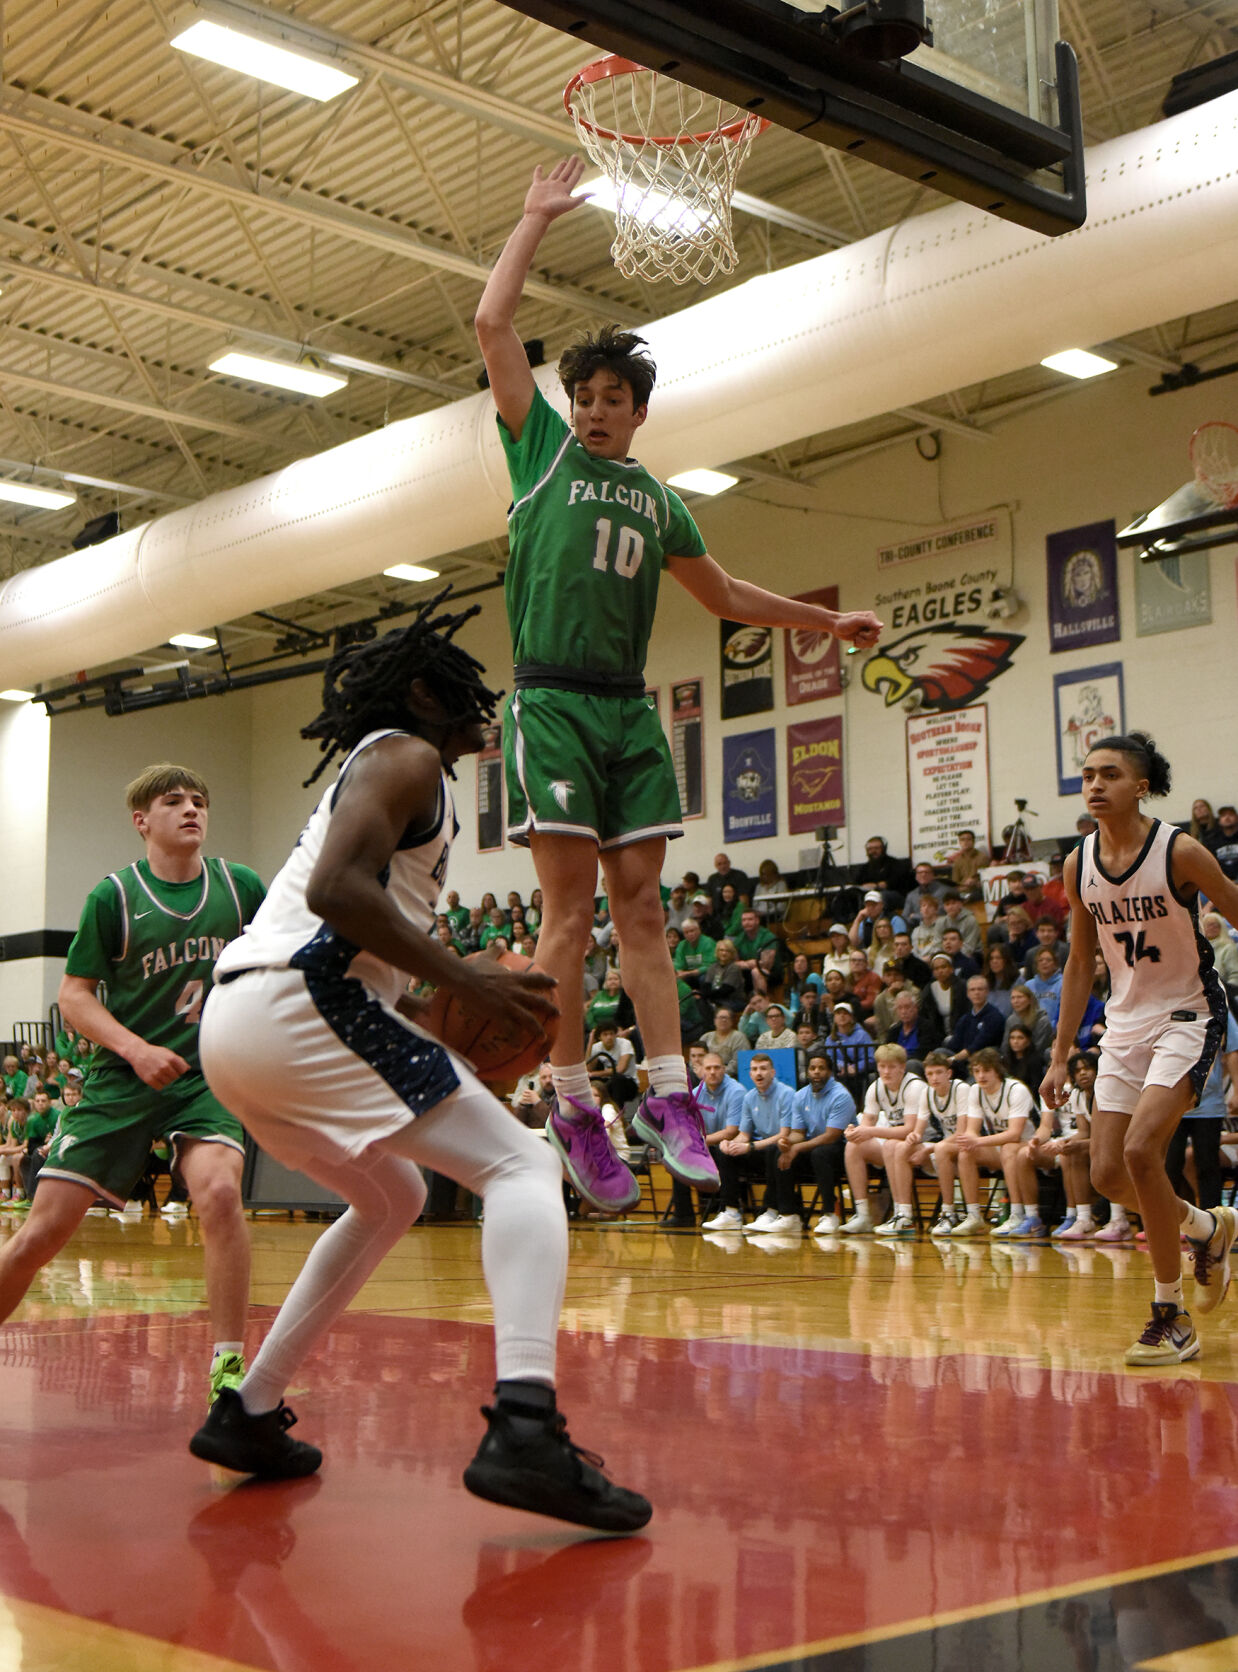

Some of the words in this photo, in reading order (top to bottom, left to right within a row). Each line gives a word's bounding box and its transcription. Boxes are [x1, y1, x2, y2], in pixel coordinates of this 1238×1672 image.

[567, 480, 660, 537] FALCON
[593, 517, 645, 579] 10
[879, 541, 933, 563] TRI-COUNTY
[935, 523, 995, 549] CONFERENCE
[875, 587, 921, 607] Southern
[925, 577, 956, 595] Boone
[960, 569, 998, 587] County
[891, 588, 983, 630] EAGLES
[1053, 615, 1115, 639] HALLSVILLE
[910, 724, 952, 745] SOUTHERN
[792, 739, 840, 767] ELDON
[923, 760, 973, 776] EXPECTATION
[728, 813, 771, 830] BOONVILLE
[794, 799, 841, 815] MUSTANGS
[1088, 895, 1169, 926] BLAZERS
[142, 936, 230, 980] FALCON
[175, 979, 204, 1024] 4
